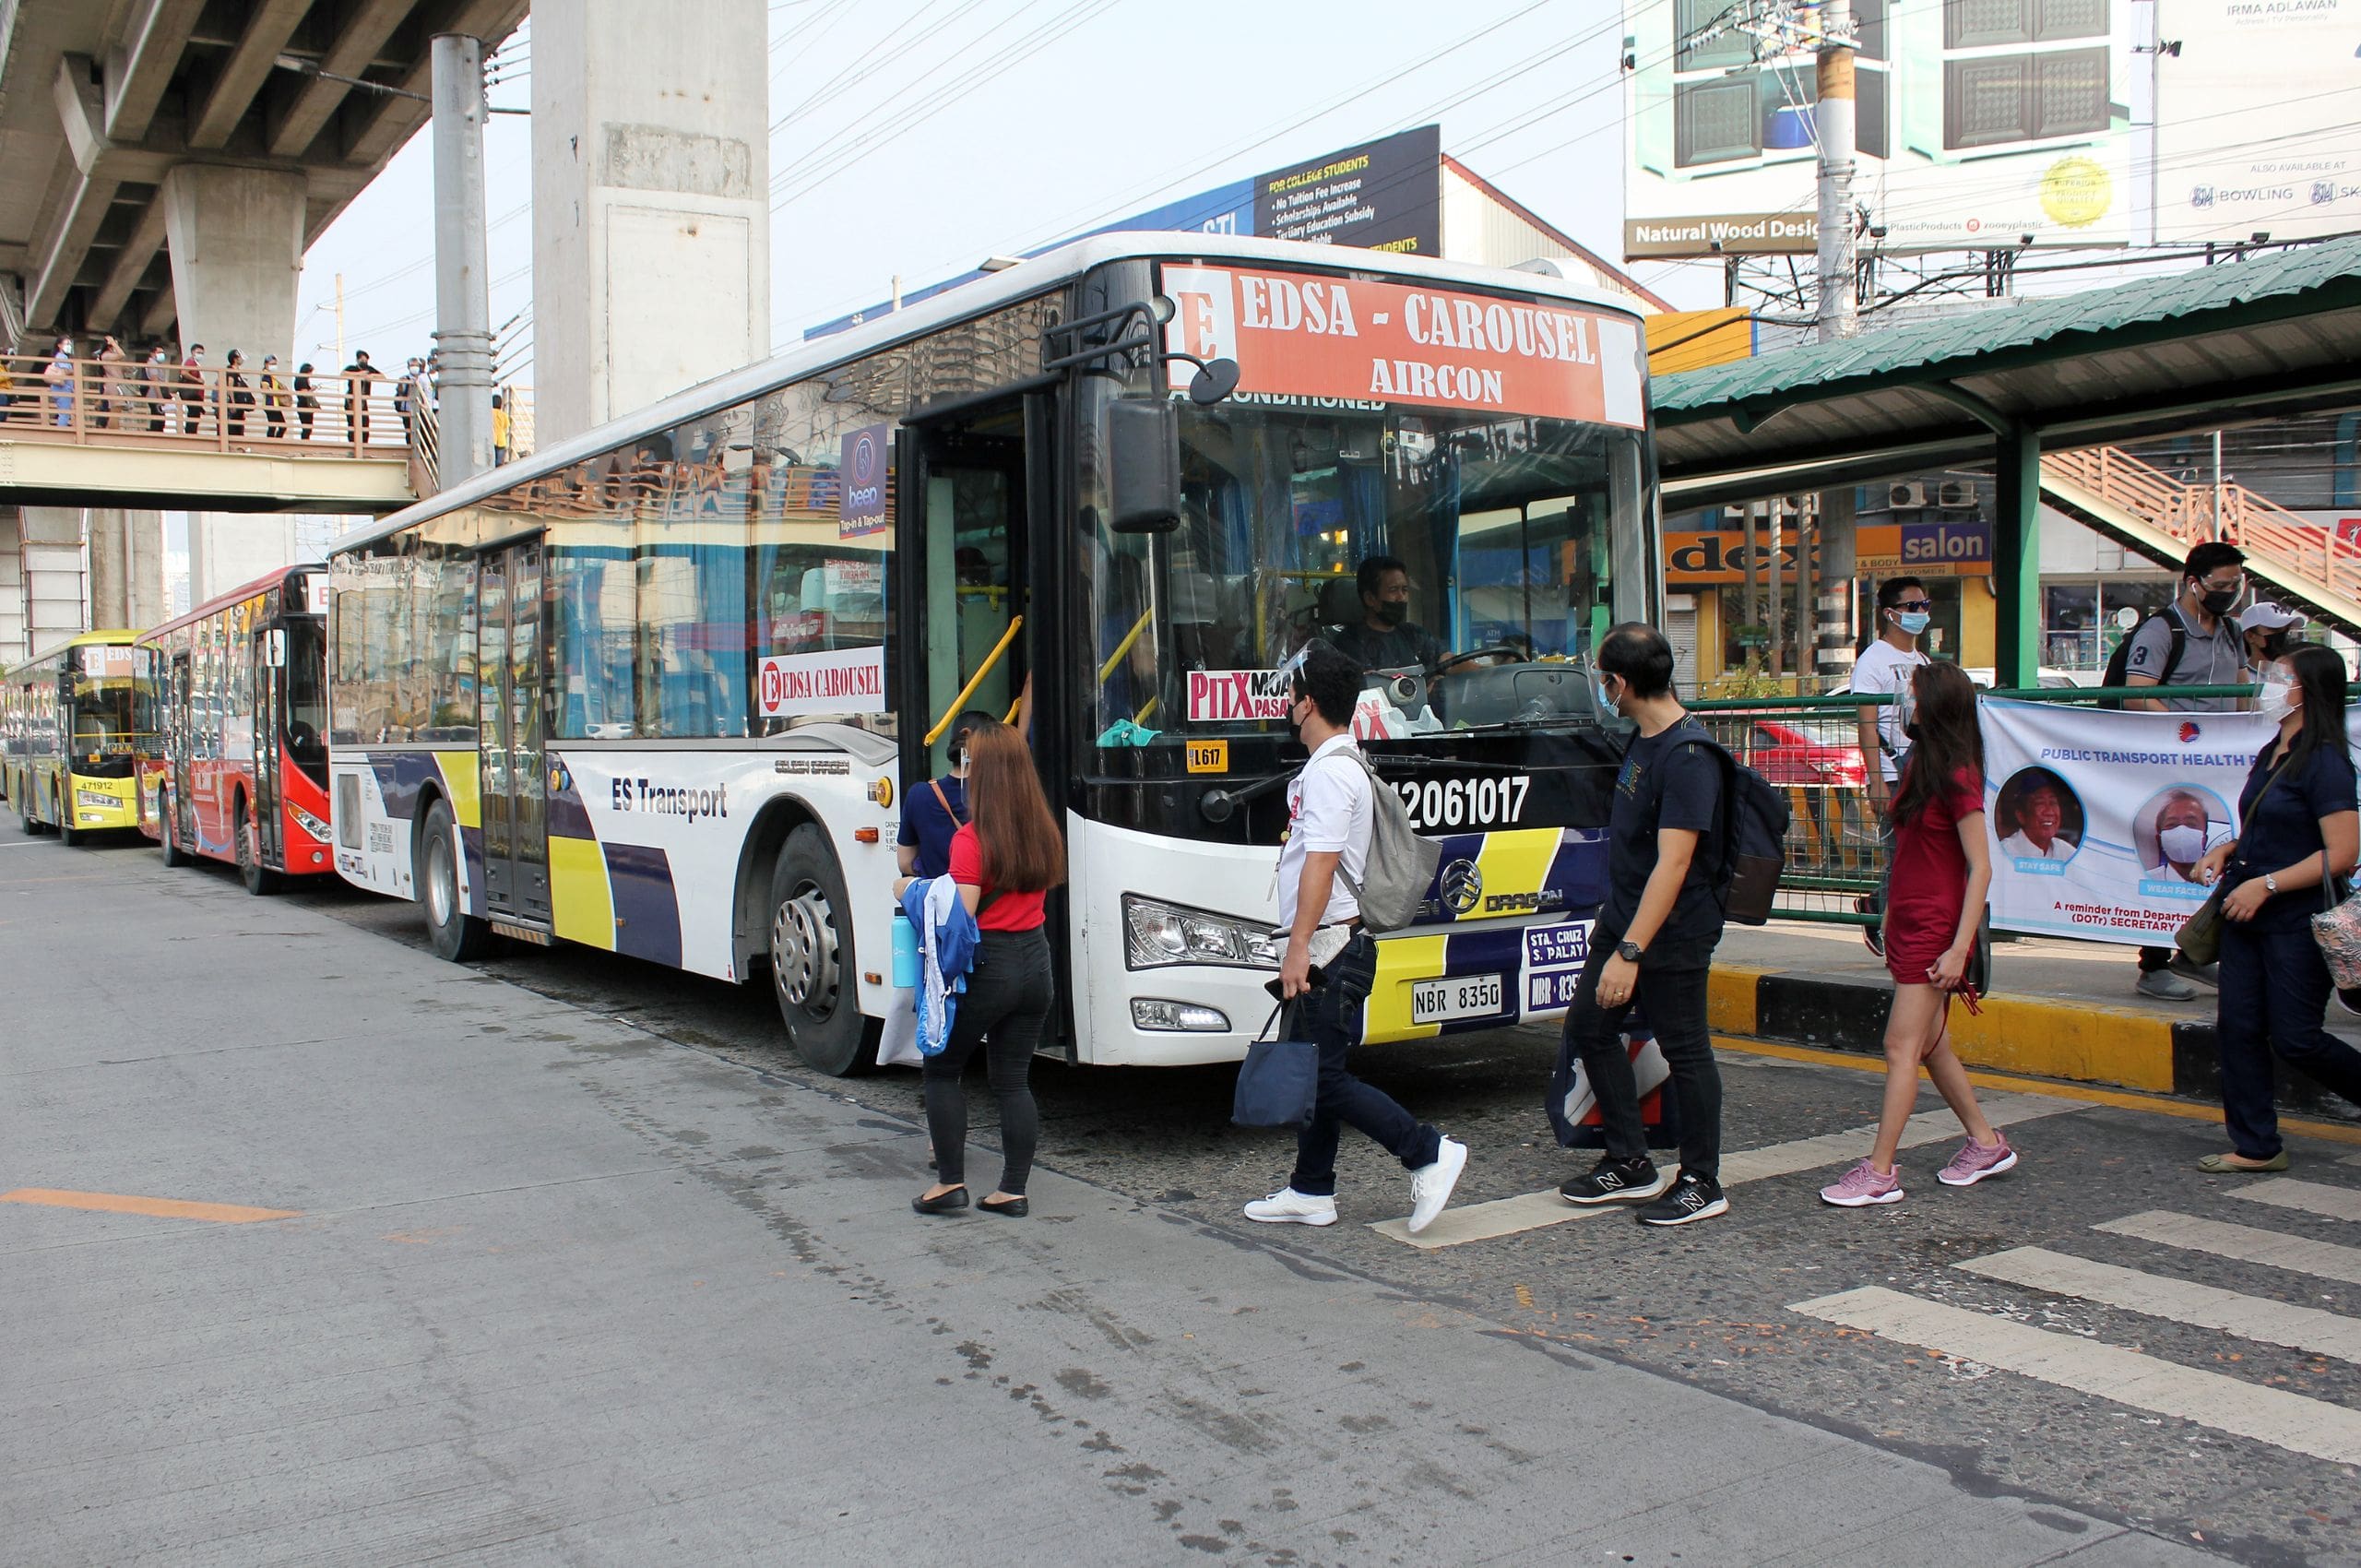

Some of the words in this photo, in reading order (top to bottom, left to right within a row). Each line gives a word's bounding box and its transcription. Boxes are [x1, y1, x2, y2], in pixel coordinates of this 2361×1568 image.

[2227, 4, 2261, 17] IRMA
[2266, 0, 2337, 14] ADLAWAN
[1269, 178, 1286, 195] FOR
[1287, 168, 1323, 192] COLLEGE
[1323, 154, 1370, 180] STUDENTS
[2250, 164, 2276, 173] ALSO
[2279, 162, 2330, 172] AVAILABLE
[2333, 161, 2346, 170] AT
[1276, 197, 1287, 209] No
[1287, 190, 1314, 208] Tuition
[1315, 186, 1329, 199] Fee
[1330, 178, 1361, 197] Increase
[2220, 188, 2294, 201] BOWLING
[2341, 187, 2361, 197] SK
[1276, 204, 1322, 227] Scholarships
[1323, 193, 1358, 215] Available
[1306, 214, 1343, 233] Education
[1344, 206, 1375, 225] Subsidy
[1635, 221, 1706, 243] Natural
[1710, 220, 1765, 240] Wood
[1770, 219, 1819, 240] Desig
[1887, 221, 1962, 232] yPlasticProducts
[1239, 275, 1358, 338] EDSA
[1405, 293, 1596, 365] CAROUSEL
[1370, 358, 1503, 404] AIRCON
[848, 485, 878, 509] beep
[840, 518, 857, 532] Tap-in
[858, 517, 862, 528] &
[862, 513, 884, 529] Tap-out
[1666, 536, 1820, 572] dex
[1904, 528, 1983, 559] salon
[1870, 559, 1899, 567] BODY
[107, 648, 133, 661] EDS
[2133, 646, 2148, 666] 3
[783, 671, 812, 700] EDSA
[815, 665, 882, 697] CAROUSEL
[1252, 671, 1291, 696] MOA
[1191, 672, 1255, 719] PITX
[1255, 698, 1289, 718] PASA
[1195, 748, 1220, 766] L617
[2040, 748, 2091, 762] PUBLIC
[2094, 751, 2178, 766] TRANSPORT
[2182, 754, 2245, 766] HEALTH
[81, 781, 113, 790] 471912
[612, 778, 633, 812] ES
[637, 778, 728, 824] Transport
[2019, 861, 2038, 870] STAY
[1485, 889, 1563, 912] DRAGON
[2146, 885, 2174, 894] WEAR
[2176, 886, 2198, 896] FACE
[2054, 901, 2062, 910] A
[2064, 903, 2112, 915] reminder
[2114, 906, 2141, 918] from
[2143, 909, 2192, 922] Departm
[2071, 914, 2107, 926] (DOTr)
[2110, 918, 2176, 932] SECRETARY
[1530, 932, 1553, 946] STA.
[1556, 929, 1583, 944] CRUZ
[1533, 948, 1543, 961] S.
[1547, 944, 1584, 960] PALAY
[1416, 989, 1447, 1015] NBR
[1459, 983, 1500, 1009] 8350
[1532, 977, 1551, 1006] NBR
[1559, 973, 1582, 1002] 835
